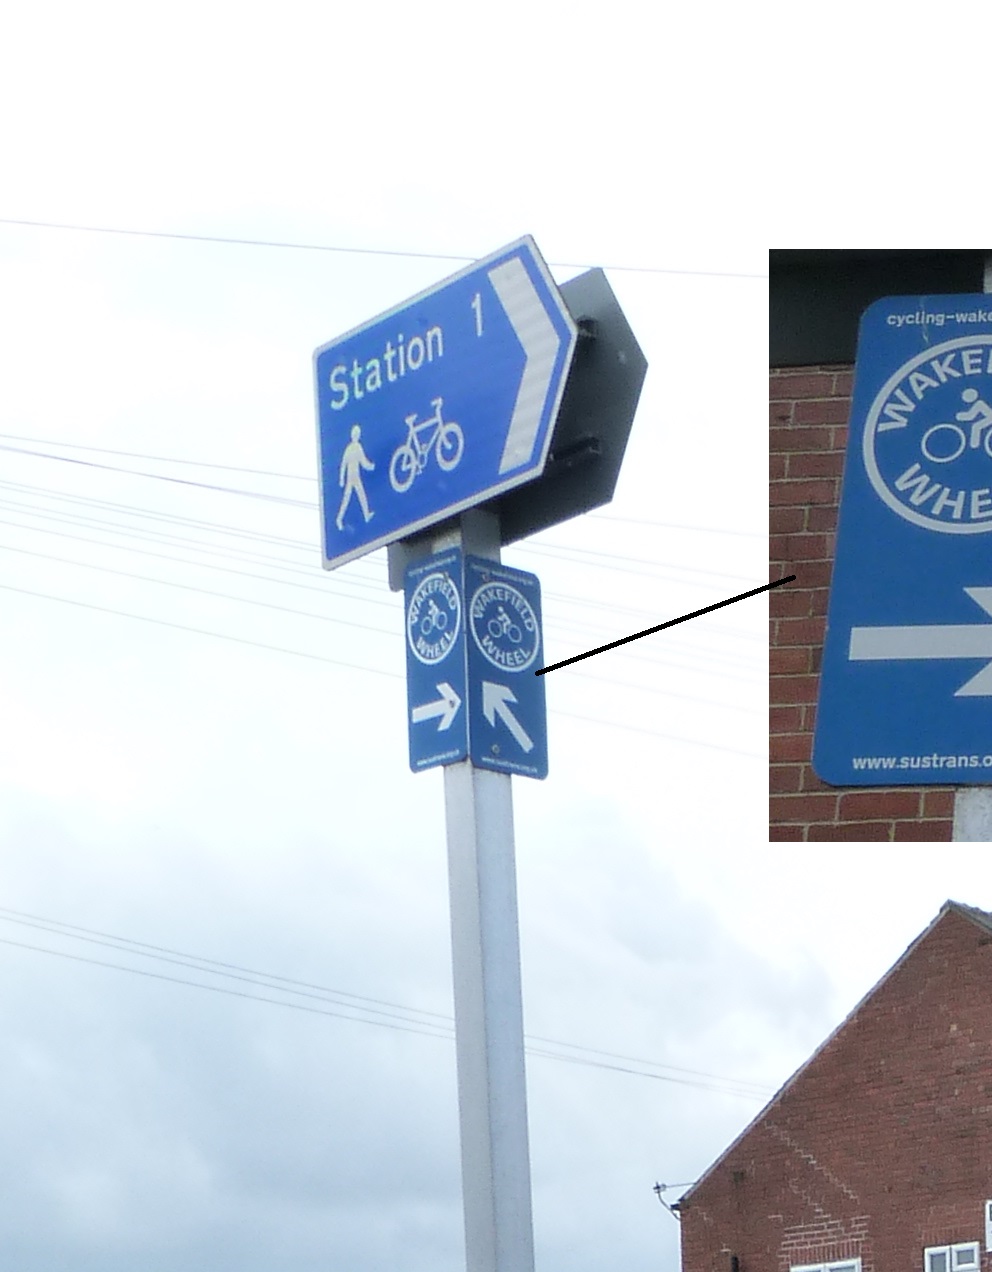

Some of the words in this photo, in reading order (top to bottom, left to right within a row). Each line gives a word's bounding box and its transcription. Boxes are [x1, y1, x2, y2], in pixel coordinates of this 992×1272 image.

[330, 326, 443, 410] Station
[471, 293, 483, 337] 1
[411, 580, 456, 624] WAKEFIELD
[474, 588, 535, 632] WAKEFIELD
[417, 631, 455, 658] WHEEL
[481, 635, 531, 666] WHEEL
